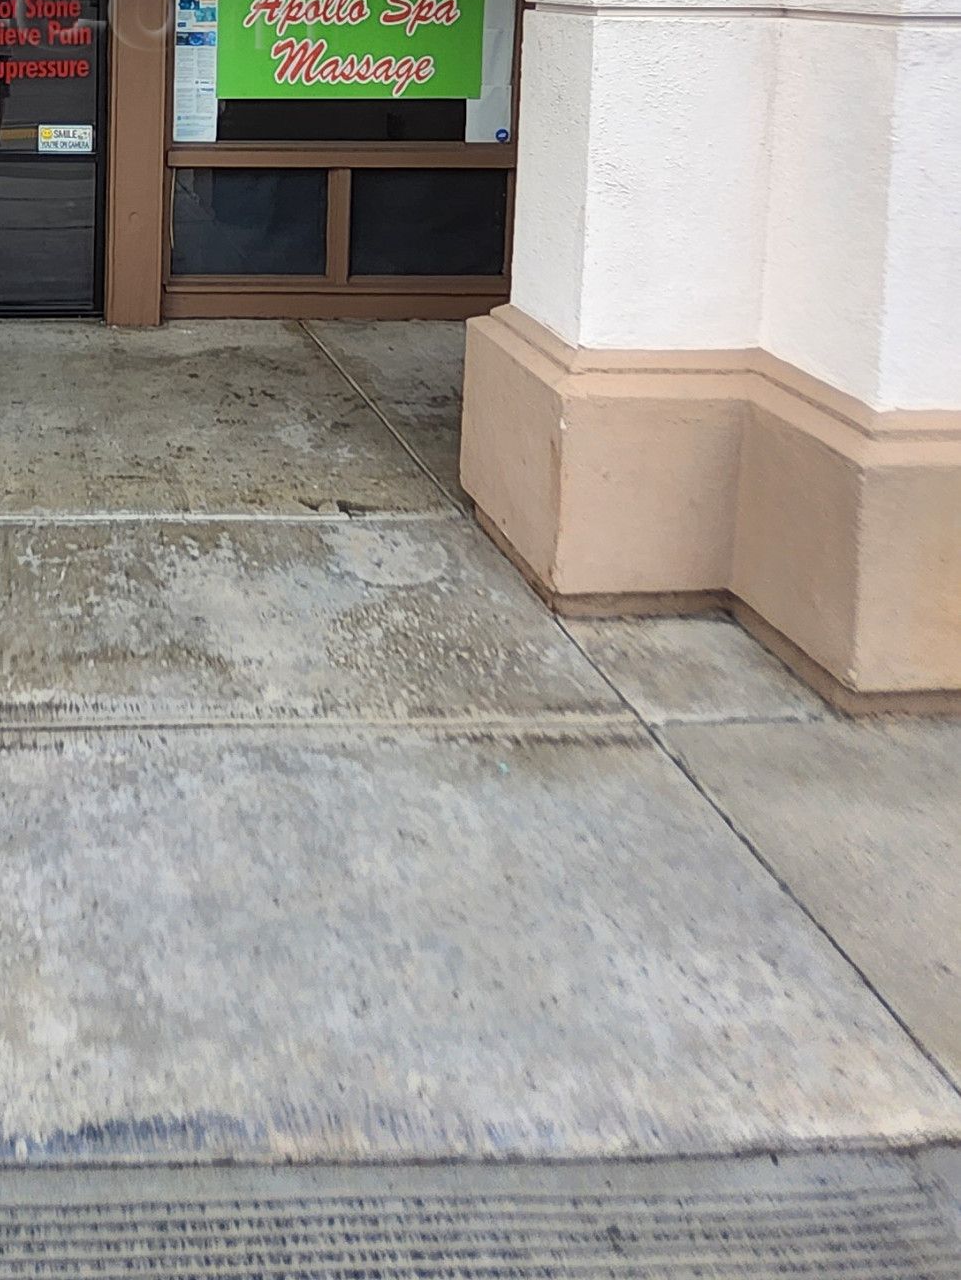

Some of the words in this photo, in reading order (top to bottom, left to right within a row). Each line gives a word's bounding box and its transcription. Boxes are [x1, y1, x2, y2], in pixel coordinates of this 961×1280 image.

[47, 19, 92, 47] Pain
[271, 38, 435, 98] Massage
[53, 129, 78, 139] SMILE
